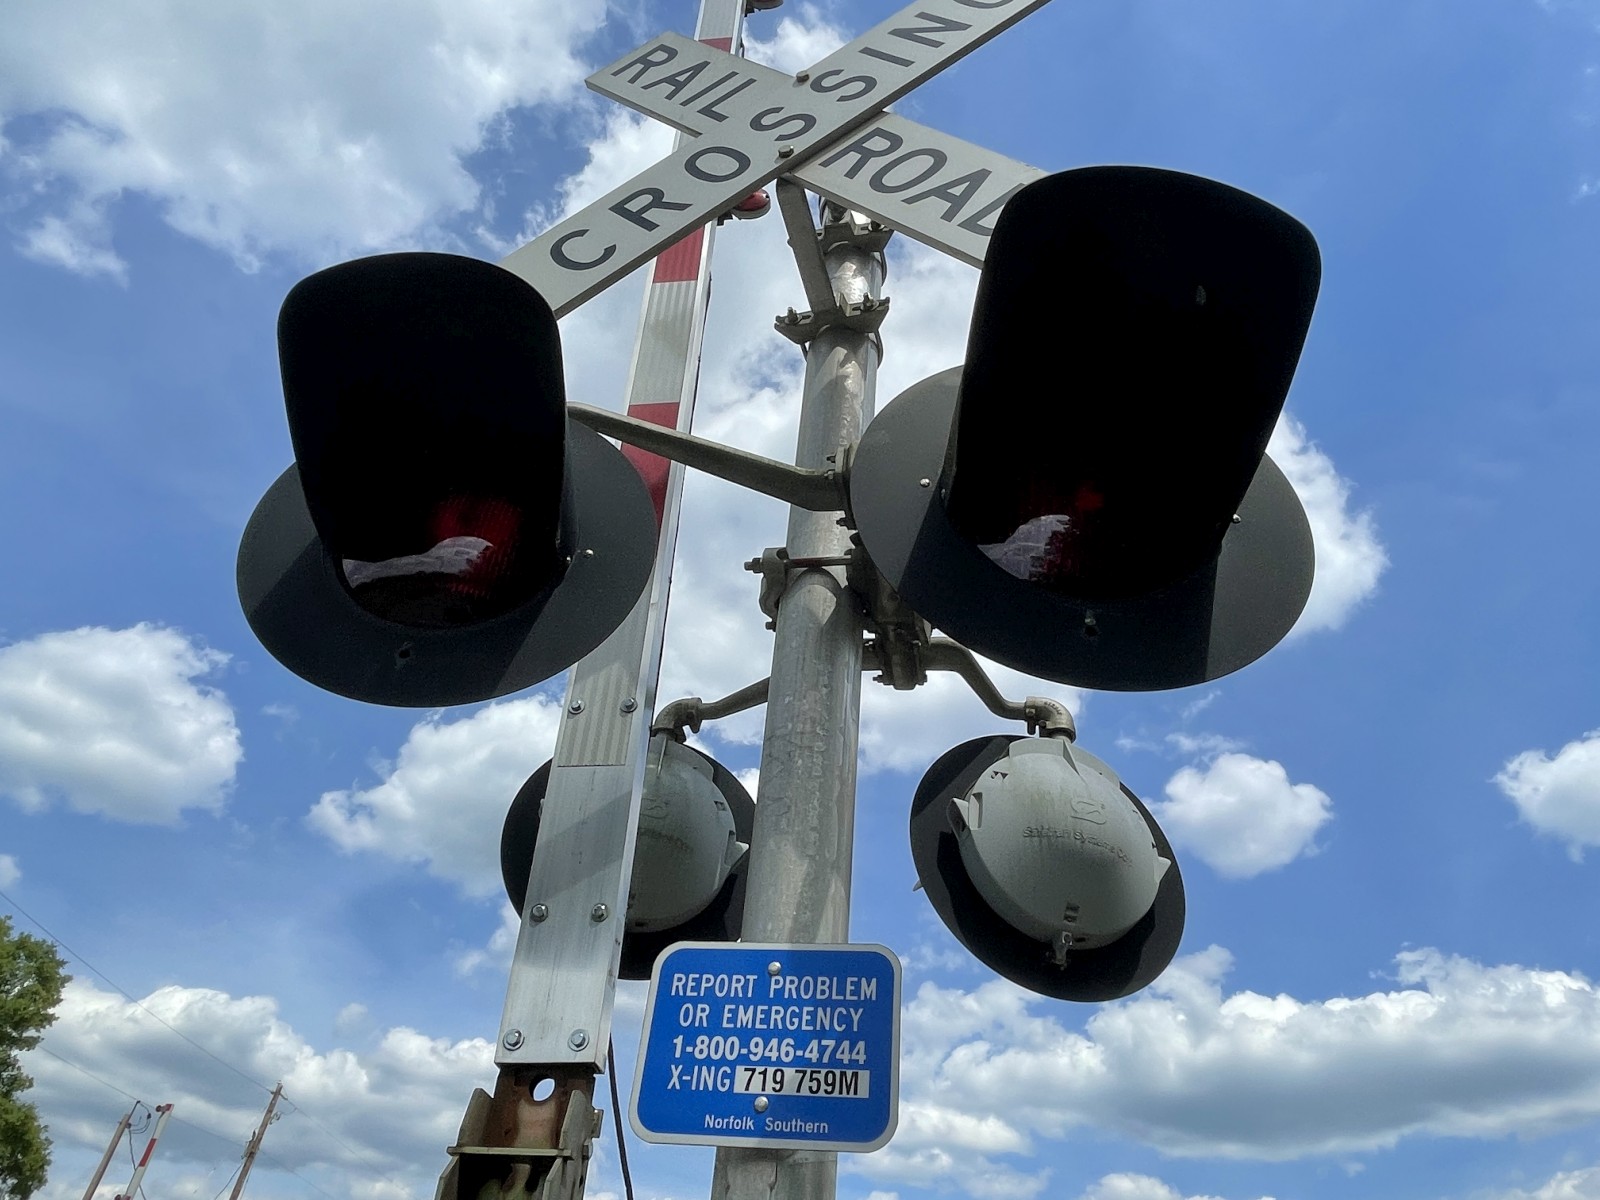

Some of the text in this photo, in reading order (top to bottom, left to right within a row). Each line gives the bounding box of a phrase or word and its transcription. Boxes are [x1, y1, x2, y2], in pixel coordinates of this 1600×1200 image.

[610, 43, 758, 123] RAIL
[550, 0, 1014, 271] CROSSIN
[670, 973, 878, 1001] REPORT PROBLEM
[679, 1003, 864, 1032] OR EMERGENCY
[672, 1035, 867, 1065] 1-800-946-4744
[667, 1064, 860, 1096] X-ING 719 759M
[704, 1114, 829, 1134] Norfolk Southern
